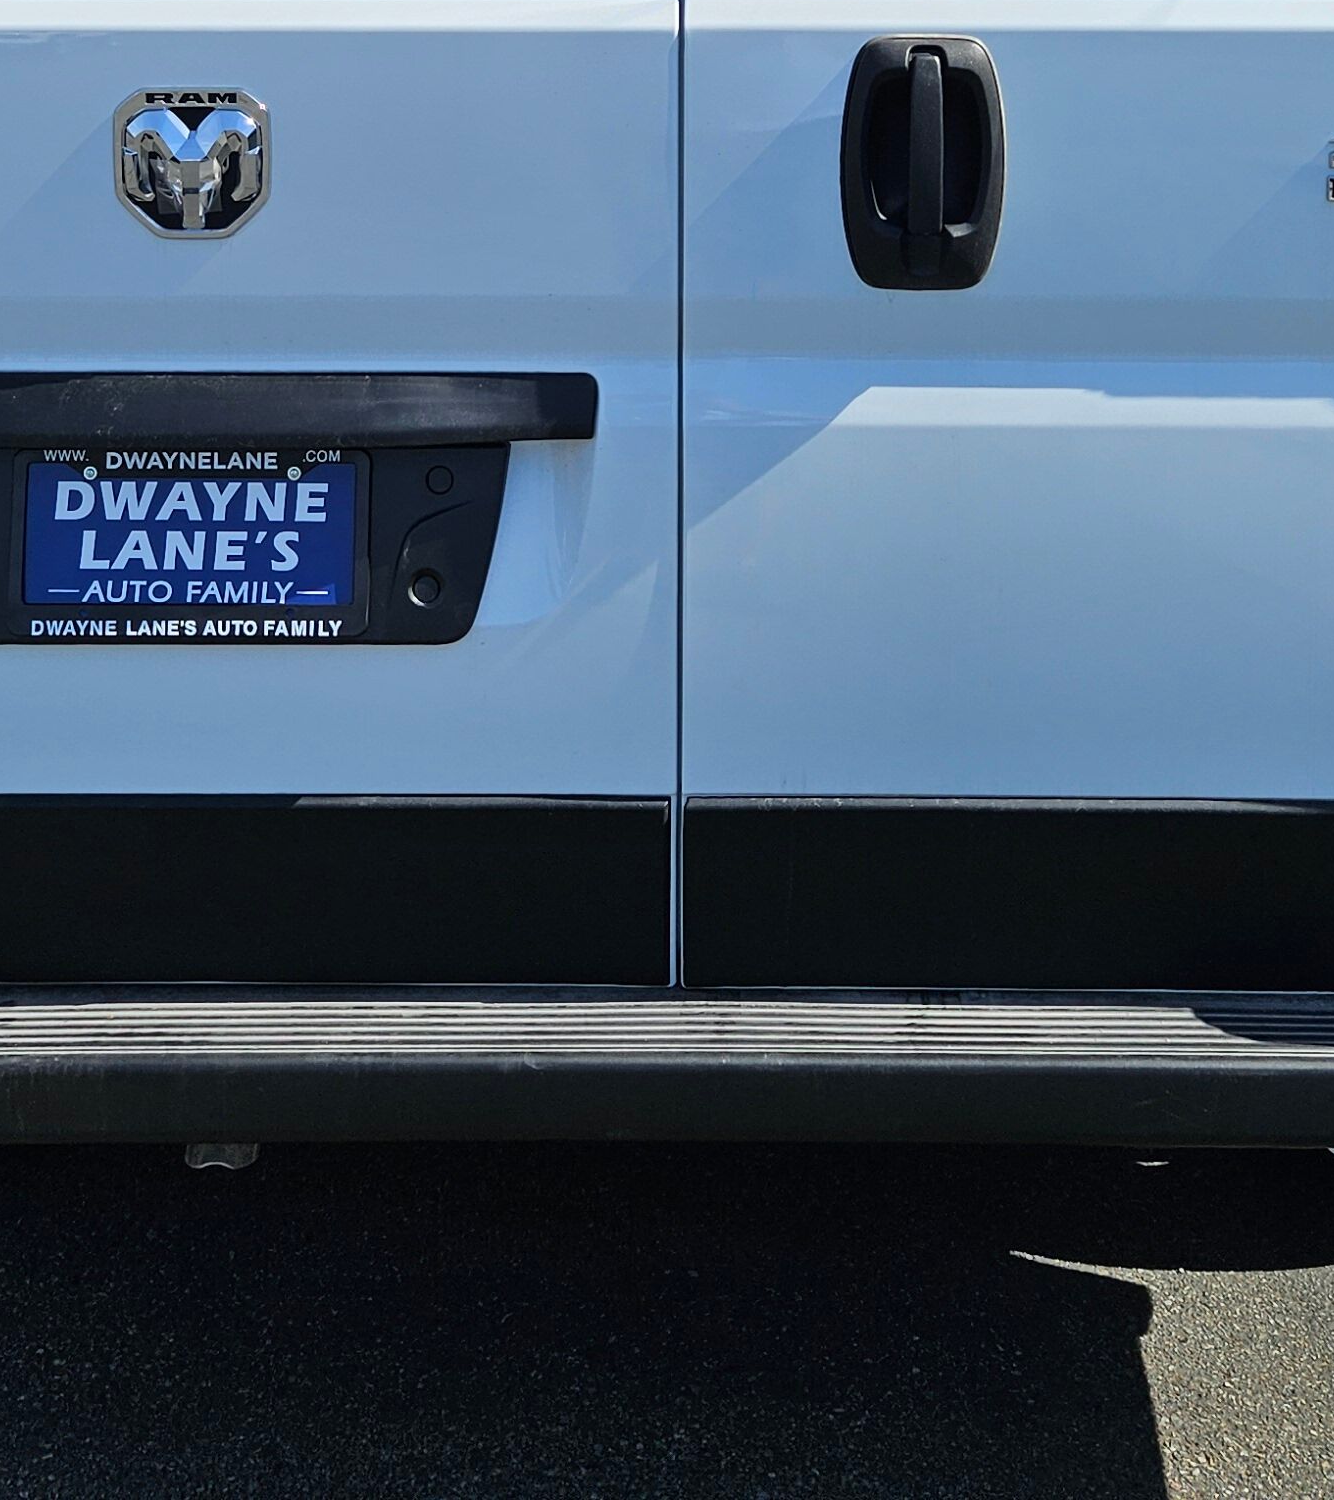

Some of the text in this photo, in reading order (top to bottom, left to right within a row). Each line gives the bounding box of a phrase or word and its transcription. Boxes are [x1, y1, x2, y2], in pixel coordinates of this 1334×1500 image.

[145, 92, 238, 104] RAM
[43, 449, 341, 470] WWW. DWAYNELANE .COM
[54, 480, 329, 522] DWAYNE
[79, 530, 300, 572] LANE'S
[81, 580, 294, 605] AUTO FAMILY
[30, 620, 343, 637] DWAYNE LANE'S AUTO FAMILY
